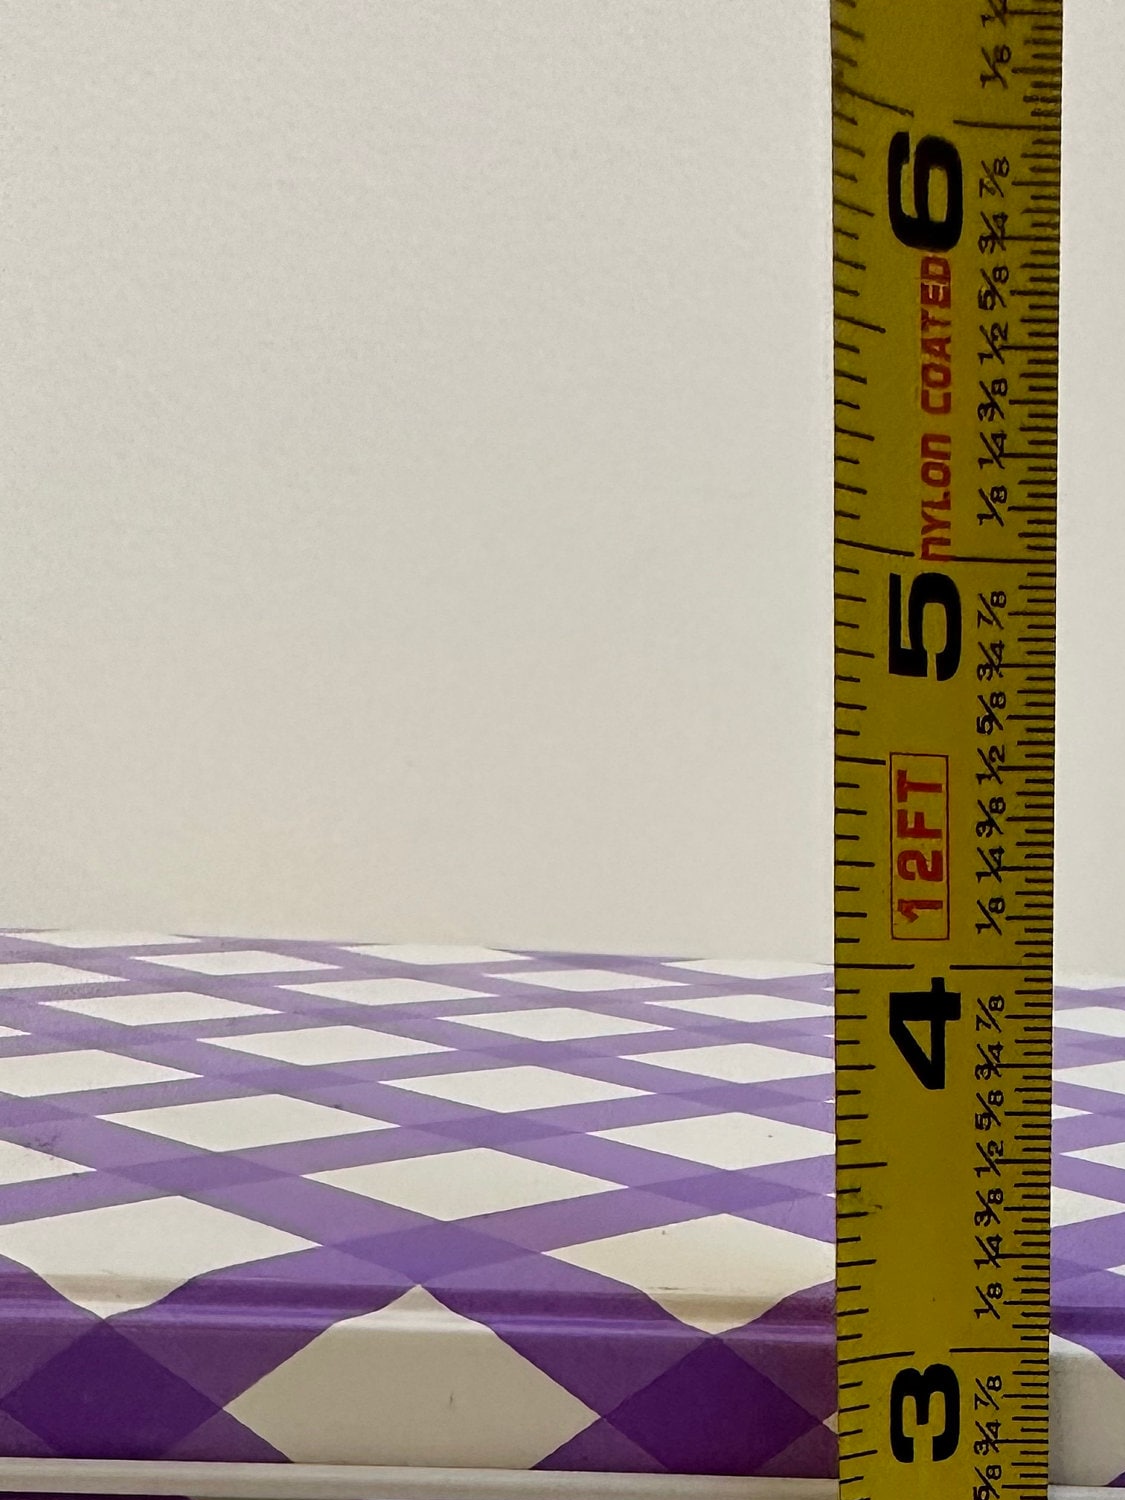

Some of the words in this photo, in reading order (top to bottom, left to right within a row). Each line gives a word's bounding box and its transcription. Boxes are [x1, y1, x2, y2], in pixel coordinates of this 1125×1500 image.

[979, 45, 1012, 89] 1/8
[888, 132, 962, 253] 6
[979, 157, 1009, 198] 7/8
[978, 211, 1008, 254] 3/4
[977, 266, 1009, 311] 5/8
[920, 256, 951, 414] COATED
[977, 322, 1008, 365] 1/2
[977, 378, 1007, 421] 3/8
[978, 431, 1007, 469] 1/4
[977, 485, 1007, 526] 1/8
[889, 572, 962, 681] 5
[977, 591, 1006, 629] 7/8
[977, 640, 1005, 681] 3/4
[976, 691, 1006, 735] 5/8
[976, 745, 1005, 784] 1/2
[976, 796, 1006, 838] 3/8
[897, 770, 943, 923] 12FT
[976, 846, 1004, 883] 1/4
[975, 897, 1005, 935] 1/8
[889, 977, 961, 1089] 4
[976, 995, 1004, 1033] 7/8
[975, 1042, 1003, 1080] 3/4
[975, 1090, 1004, 1130] 5/8
[974, 1140, 1003, 1177] 1/2
[974, 1188, 1003, 1226] 3/8
[974, 1234, 1002, 1270] 1/4
[974, 1282, 1002, 1319] 1/8
[890, 1363, 960, 1463] 3
[974, 1376, 1002, 1410] 7/8
[974, 1419, 1001, 1455] 3/4
